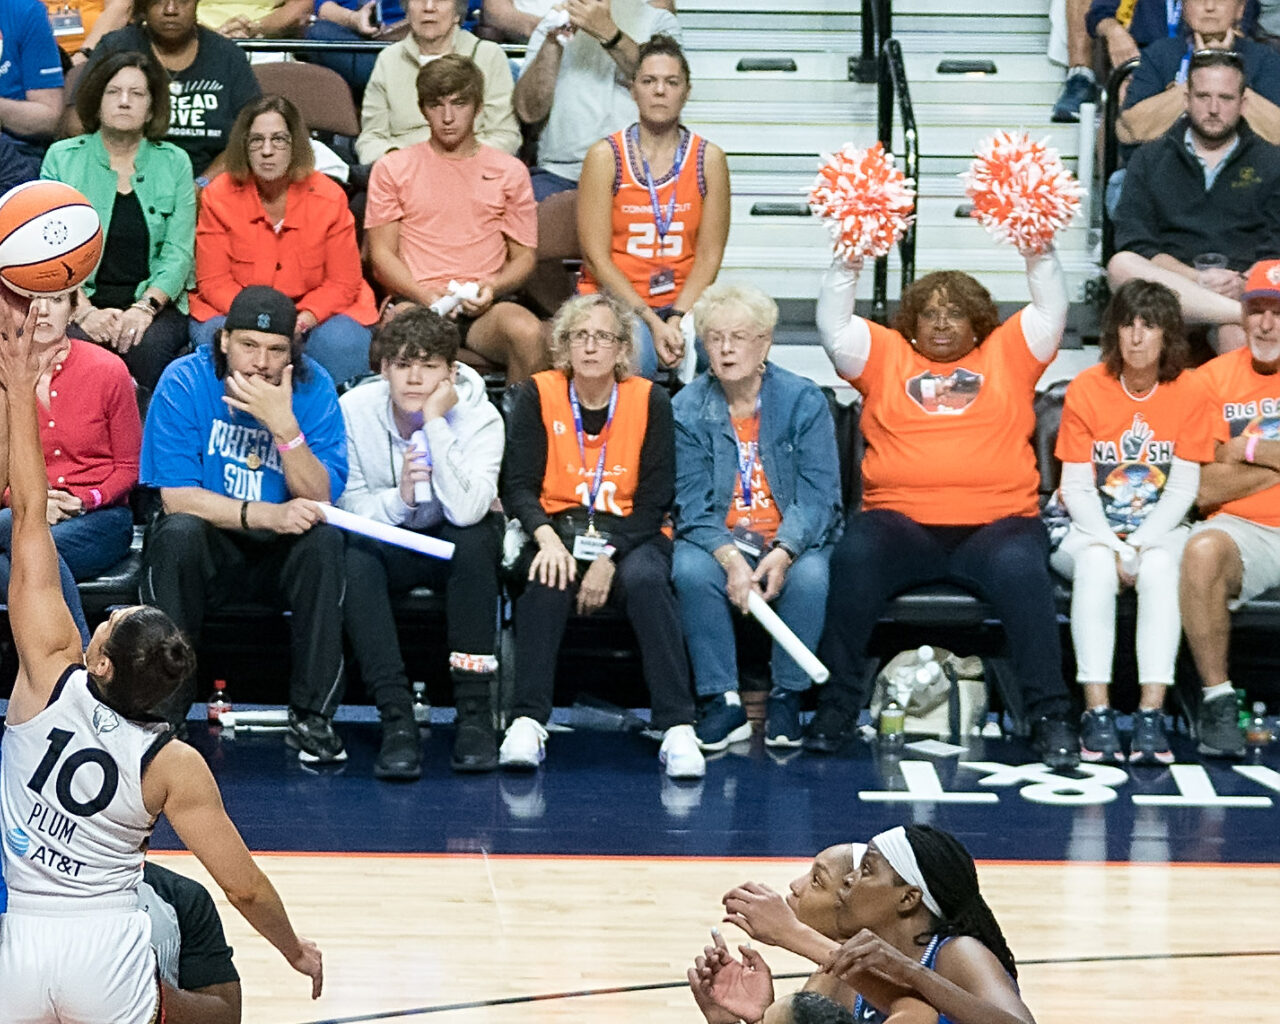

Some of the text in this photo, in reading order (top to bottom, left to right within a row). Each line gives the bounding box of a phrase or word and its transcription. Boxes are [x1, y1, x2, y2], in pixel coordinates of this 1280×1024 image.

[626, 222, 685, 258] 25
[1224, 400, 1280, 420] BIG GA
[1092, 441, 1172, 462] NA SH
[223, 462, 265, 502] SUN
[26, 726, 120, 818] 10
[27, 802, 78, 845] PLUM
[29, 845, 87, 878] AT&T
